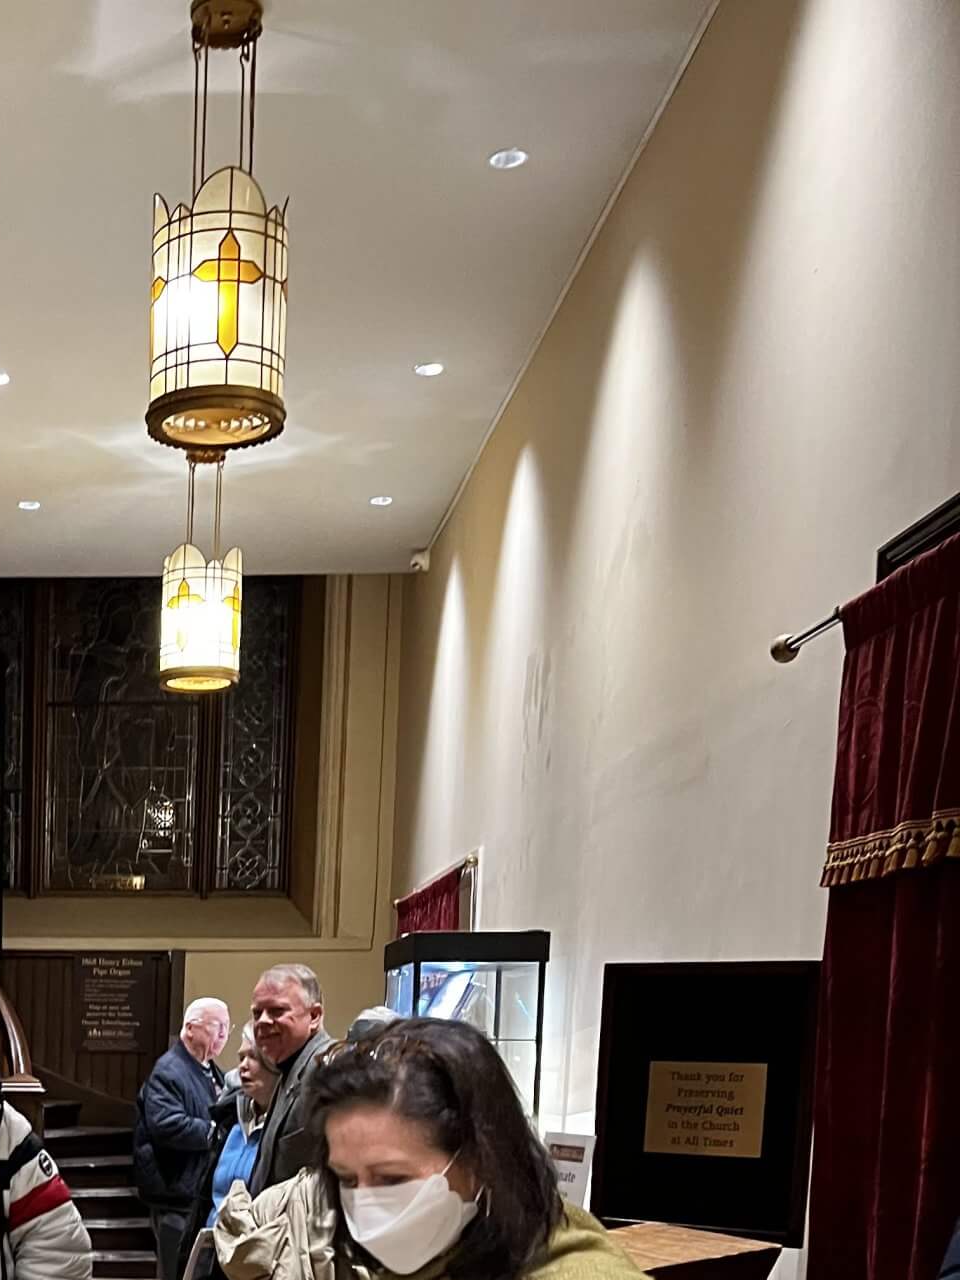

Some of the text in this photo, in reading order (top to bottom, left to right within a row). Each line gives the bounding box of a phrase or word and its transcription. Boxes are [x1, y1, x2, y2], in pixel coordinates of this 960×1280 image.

[110, 968, 130, 976] Organ
[671, 1072, 744, 1084] Thank you for
[678, 1088, 735, 1100] Preserving
[666, 1104, 744, 1117] Prayerful Quiet
[668, 1120, 740, 1132] in the Church
[671, 1136, 734, 1148] at All Times
